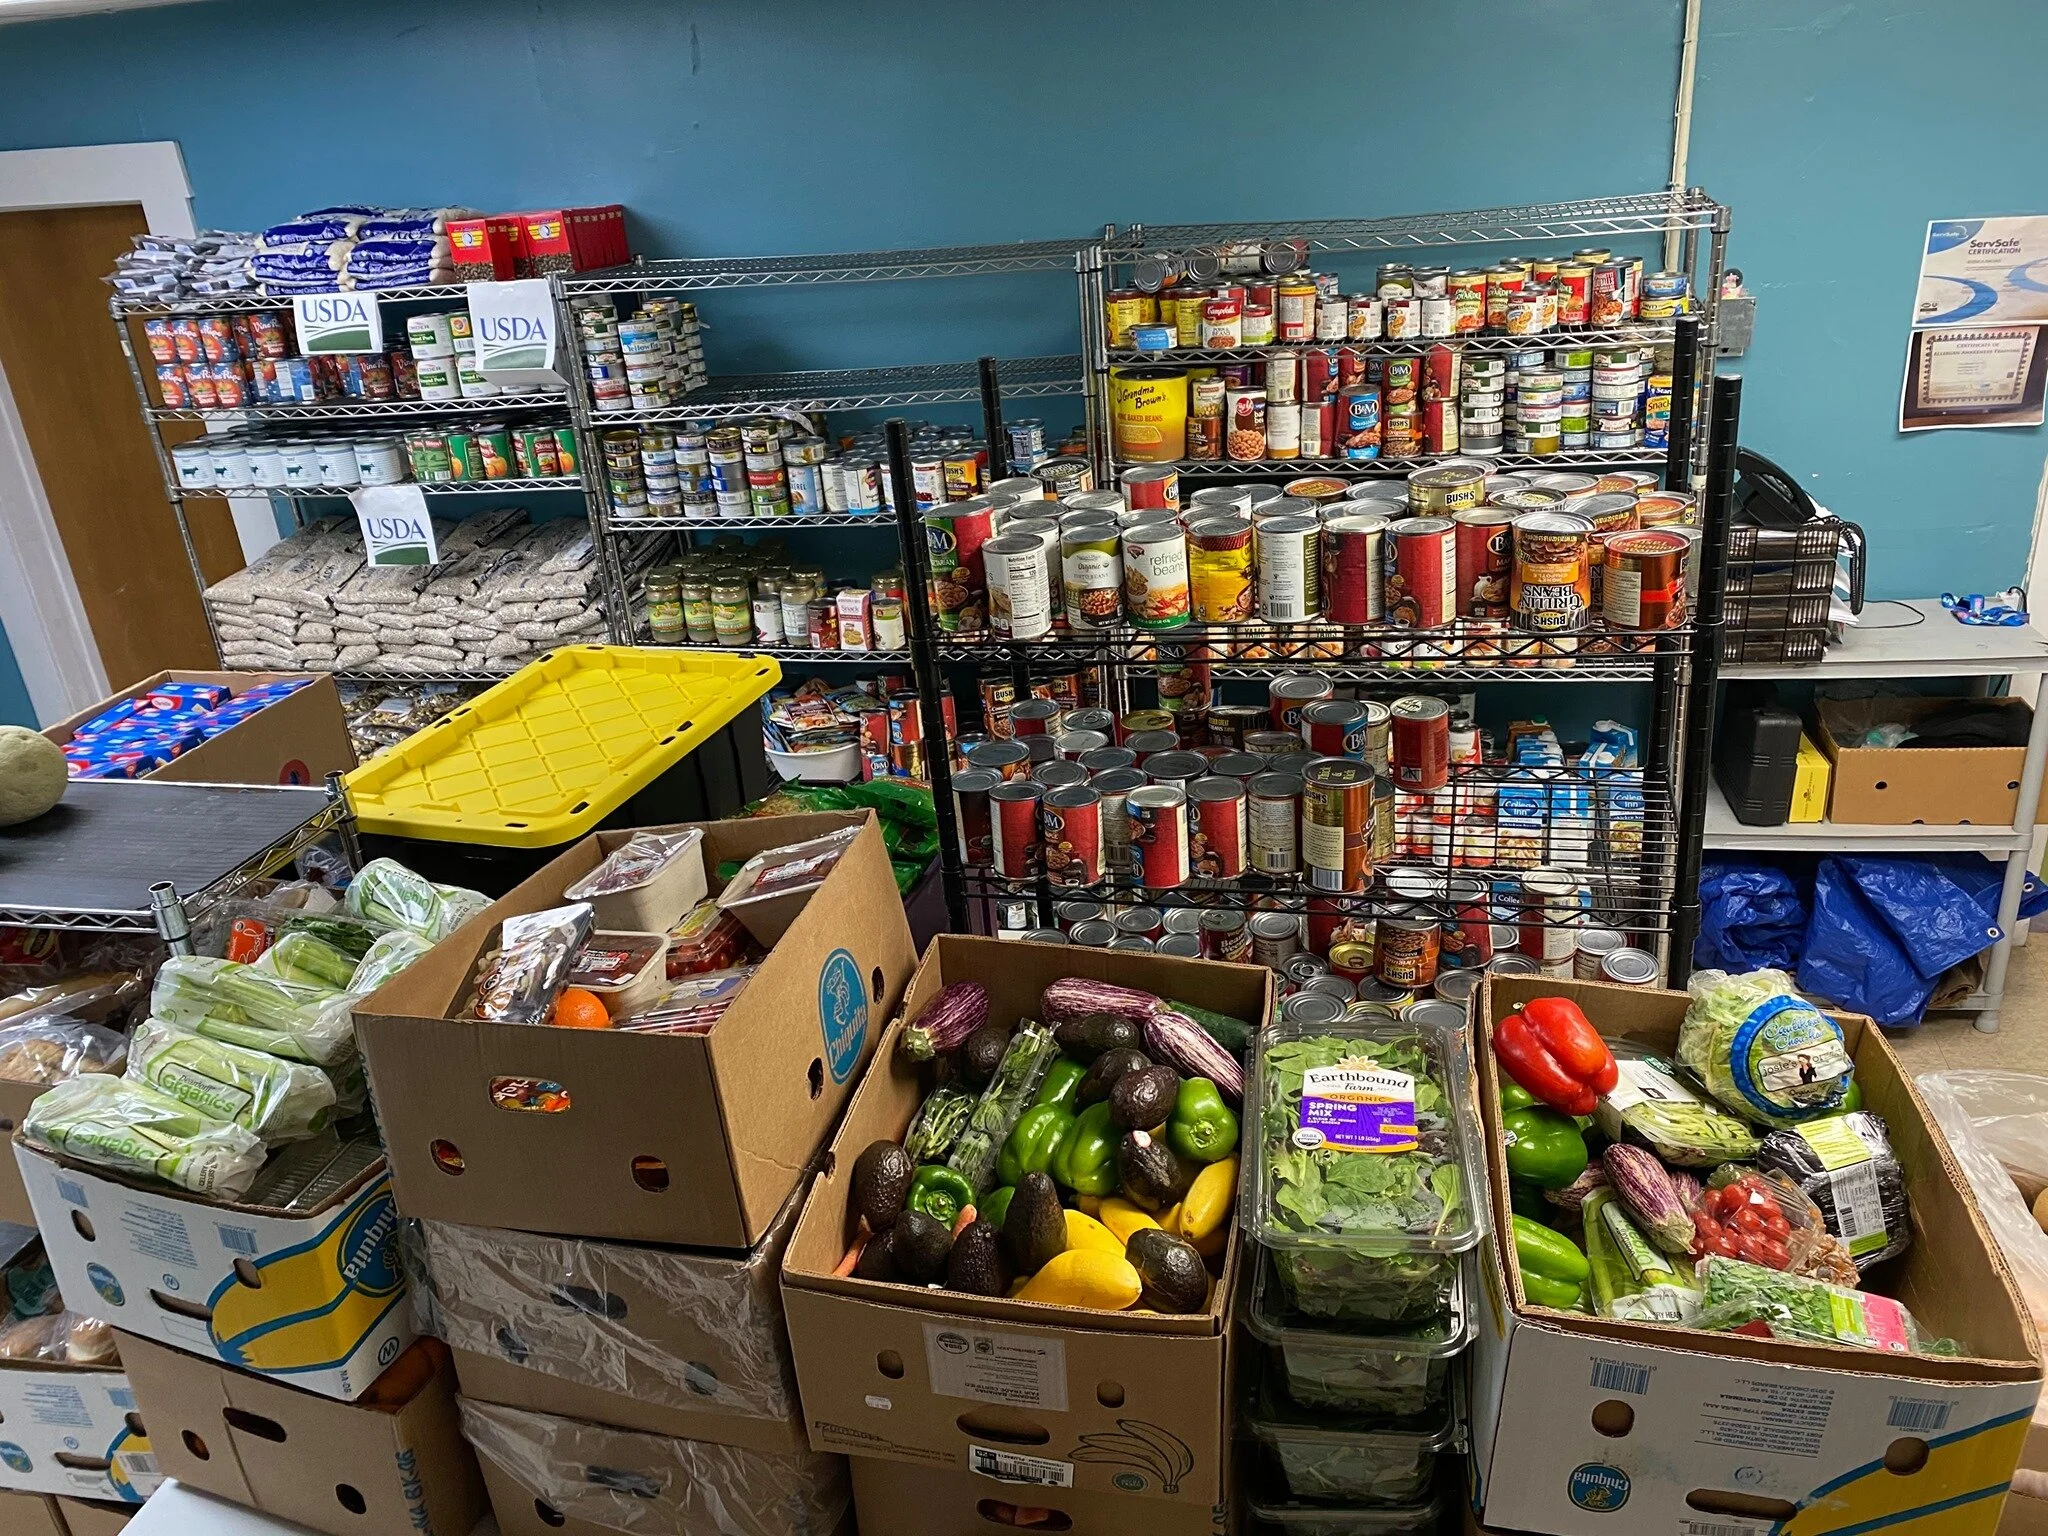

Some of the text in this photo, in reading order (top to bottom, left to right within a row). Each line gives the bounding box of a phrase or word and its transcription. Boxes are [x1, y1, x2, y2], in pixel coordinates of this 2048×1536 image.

[1970, 238, 2020, 248] ServSafe
[302, 299, 368, 323] USDA
[253, 320, 271, 332] Vine
[480, 317, 547, 341] USDA
[1392, 365, 1409, 375] B&M
[1122, 385, 1155, 401] Grandma
[1135, 394, 1167, 410] Brown's
[1354, 402, 1376, 415] B&M
[1127, 414, 1144, 422] BAKED
[1389, 420, 1409, 428] BUSH'S
[1446, 490, 1475, 505] BUSH'S
[367, 517, 426, 540] USDA
[1149, 550, 1183, 566] refried
[1153, 562, 1185, 577] beans
[1523, 584, 1573, 597] BEANS
[1518, 594, 1585, 611] GRILLIN'
[1533, 615, 1566, 626] BUSH'S
[1304, 789, 1327, 804] BUSH'S
[1514, 808, 1527, 816] Inn
[1386, 969, 1414, 980] BUSH'S
[829, 1004, 867, 1069] Chiquita
[1763, 1059, 1798, 1077] josie's
[1309, 1072, 1409, 1089] Earthbound
[1344, 1082, 1375, 1092] Farm
[161, 1074, 236, 1113] Organics
[1330, 1093, 1387, 1103] ORGANIC
[1308, 1102, 1358, 1112] SPRING
[1308, 1109, 1333, 1117] MIX
[343, 1196, 398, 1279] hiquita
[1573, 1471, 1630, 1491] Chiquita
